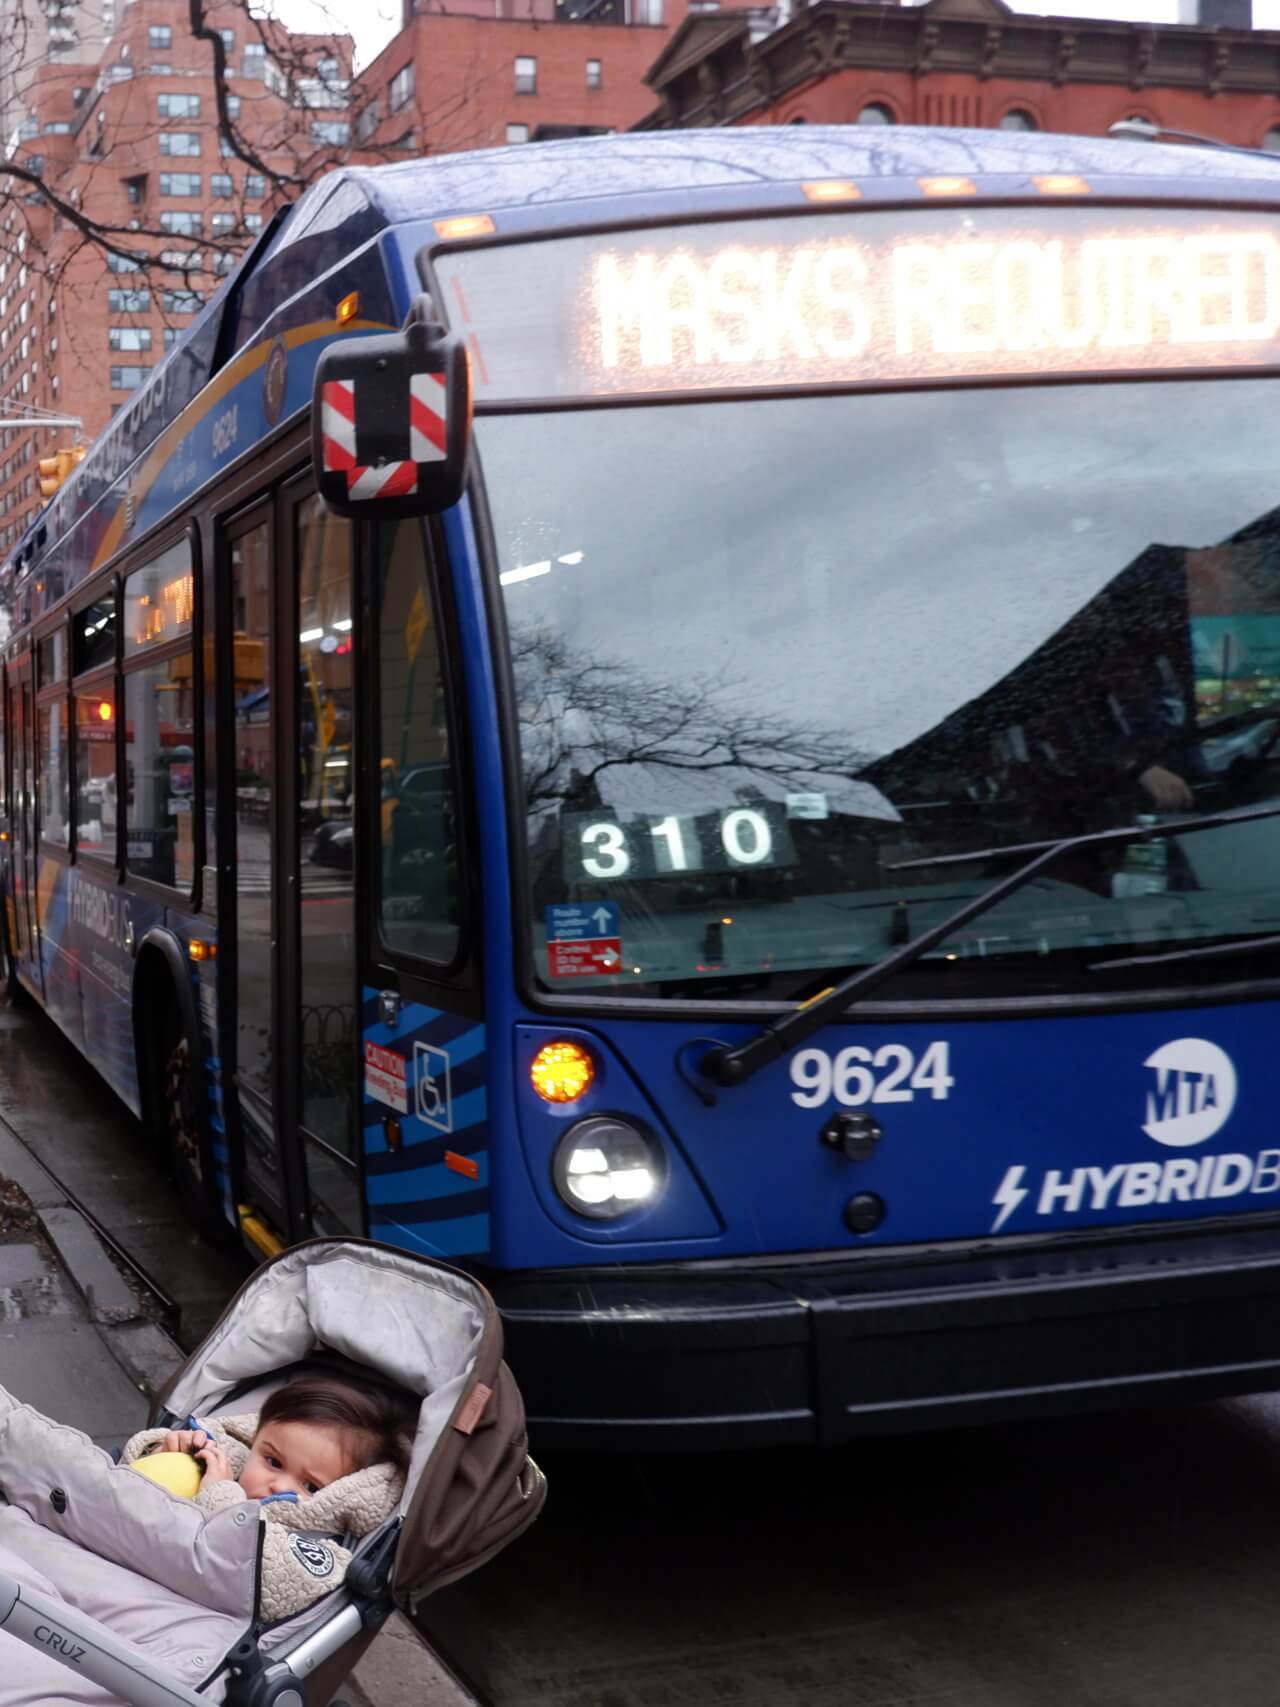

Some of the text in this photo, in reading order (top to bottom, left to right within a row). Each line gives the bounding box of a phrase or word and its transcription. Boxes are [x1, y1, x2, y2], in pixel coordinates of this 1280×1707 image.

[598, 231, 1280, 367] MASKS REQUIRED
[552, 908, 582, 918] Route
[552, 918, 590, 928] number
[553, 928, 584, 937] above
[366, 1042, 405, 1079] CAUTION
[790, 1041, 955, 1109] 9624
[1035, 1147, 1280, 1215] HYBRIDB
[33, 1625, 87, 1664] CRUZ
